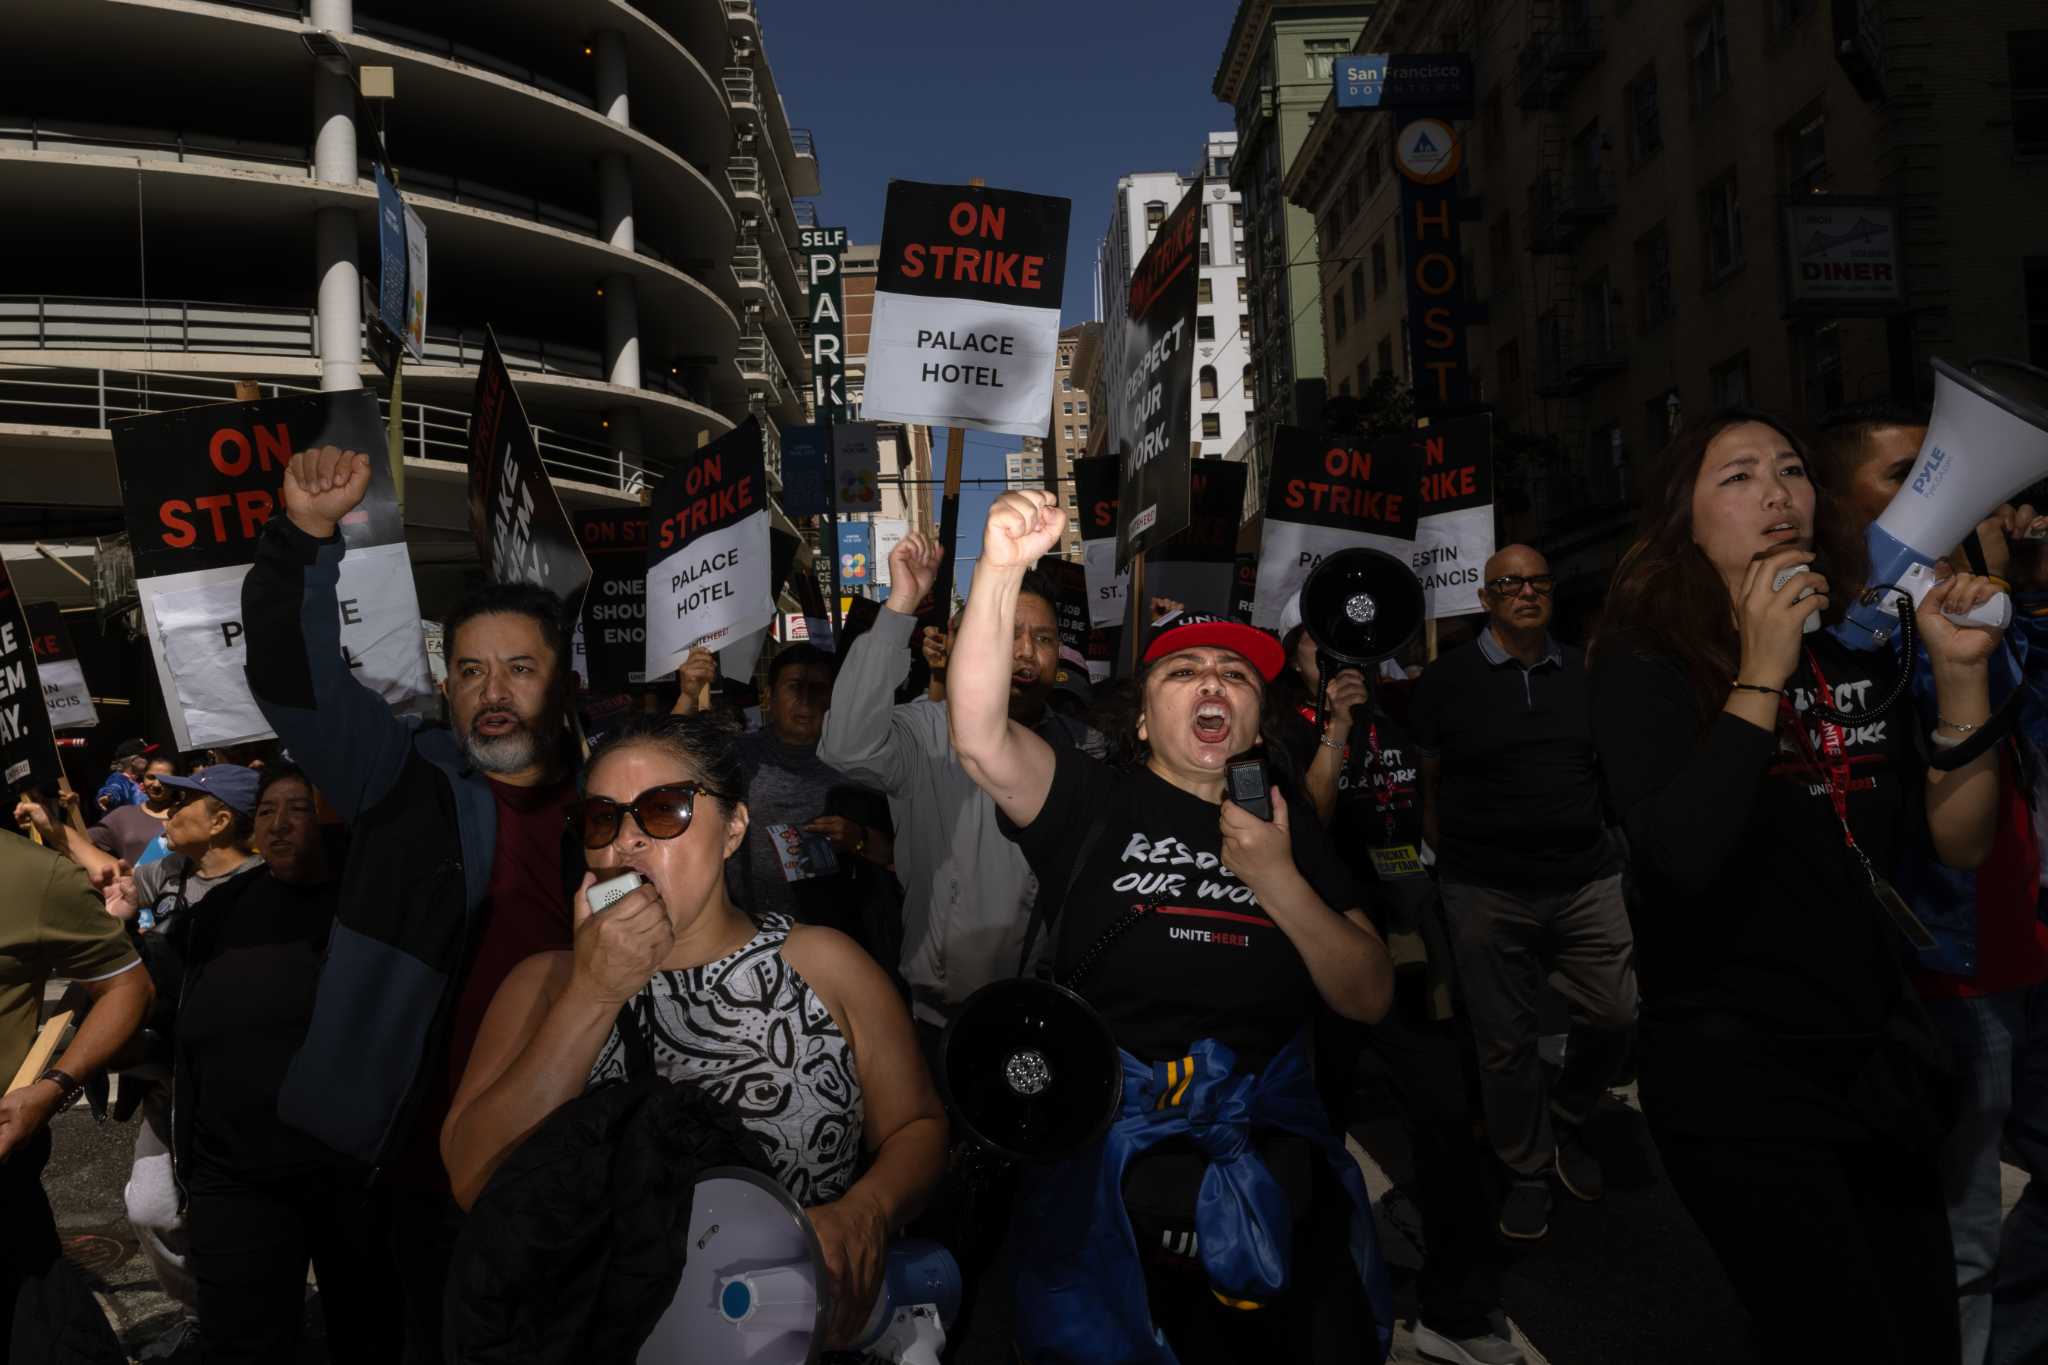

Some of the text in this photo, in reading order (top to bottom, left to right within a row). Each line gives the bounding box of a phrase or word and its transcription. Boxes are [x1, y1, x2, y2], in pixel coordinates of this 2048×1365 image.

[1348, 67, 1377, 81] San
[801, 230, 844, 247] SELF
[949, 200, 1005, 240] ON
[900, 243, 1044, 290] STRIKE
[1801, 262, 1893, 280] DINER
[810, 254, 844, 406] PARK
[917, 329, 1014, 356] PALACE
[921, 362, 1004, 388] HOTEL
[1126, 318, 1185, 401] RESPECT
[1133, 383, 1163, 431] OUR
[209, 422, 293, 477] ON
[1127, 429, 1170, 483] WORK.
[1325, 447, 1373, 480] ON
[1425, 436, 1446, 465] N
[686, 454, 722, 497] ON
[1419, 463, 1478, 503] RIKE
[1912, 447, 1946, 495] PYLE
[659, 475, 753, 549] STRIKE
[1284, 479, 1405, 523] STRIKE
[672, 549, 739, 592] PALACE
[1412, 546, 1457, 568] ESTIN
[603, 580, 646, 596] ONE
[677, 581, 735, 619] HOTEL
[592, 604, 646, 621] SHOU
[604, 627, 646, 644] ENO
[1120, 833, 1234, 877] RESP
[1112, 872, 1258, 906] OUR WO
[1169, 927, 1249, 947] UNITEHERE!
